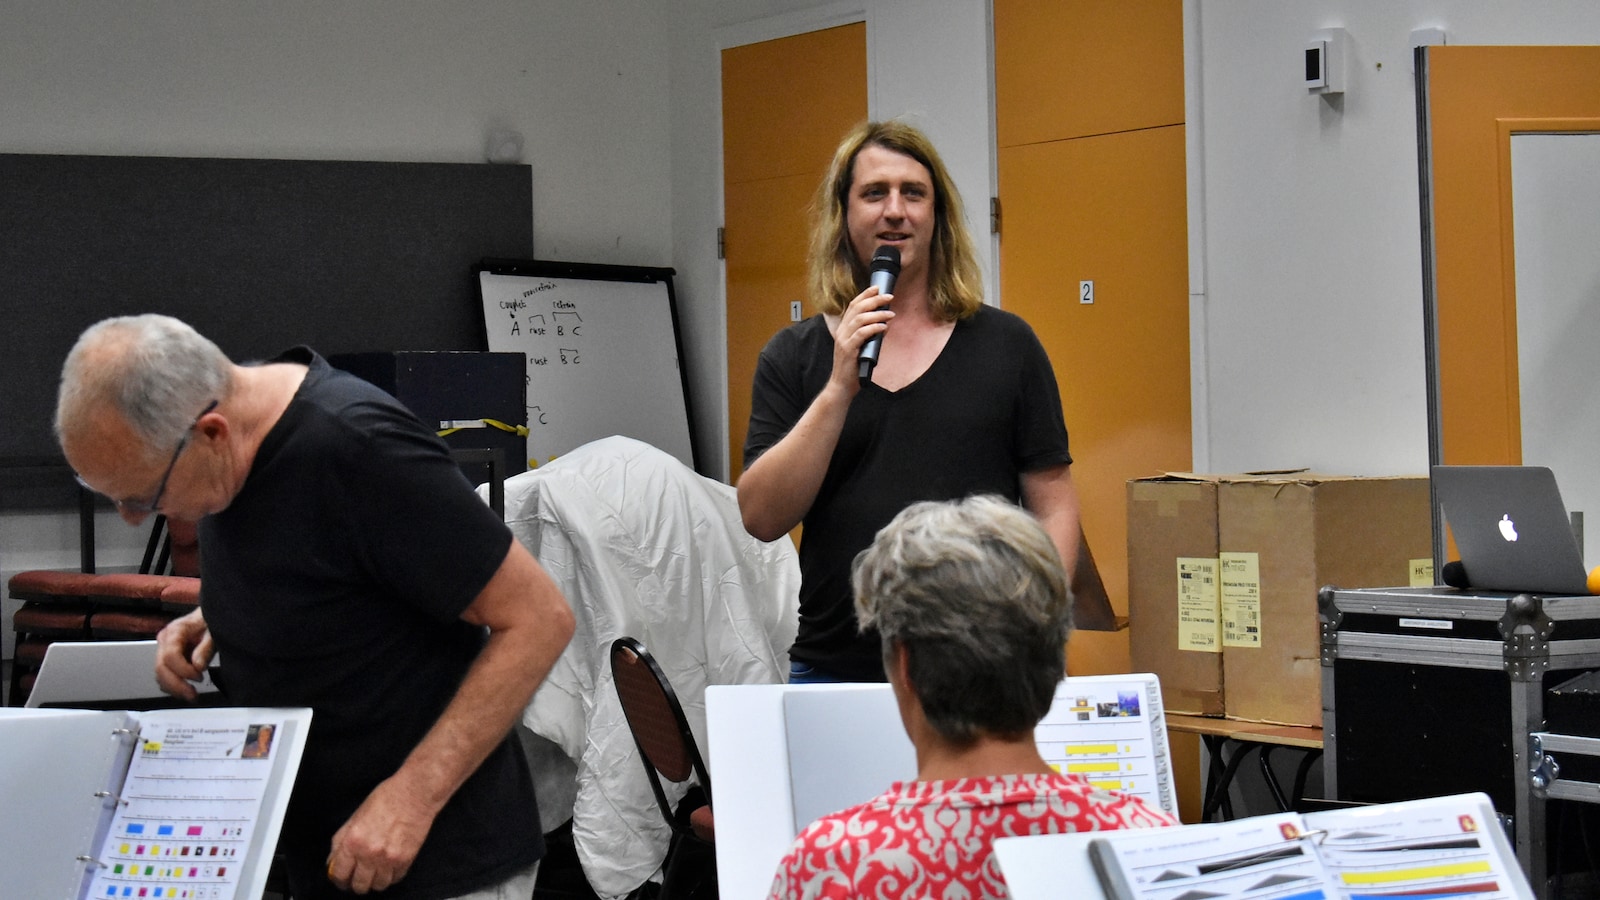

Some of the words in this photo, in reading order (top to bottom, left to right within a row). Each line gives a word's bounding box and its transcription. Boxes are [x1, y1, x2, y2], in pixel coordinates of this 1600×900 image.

[1082, 283, 1091, 301] 2
[792, 304, 798, 319] 1
[511, 321, 520, 336] A
[529, 328, 546, 336] rust
[557, 325, 564, 336] B
[572, 326, 582, 336] C
[530, 357, 548, 366] rust
[560, 354, 568, 365] B
[573, 356, 581, 364] C
[539, 413, 548, 425] C
